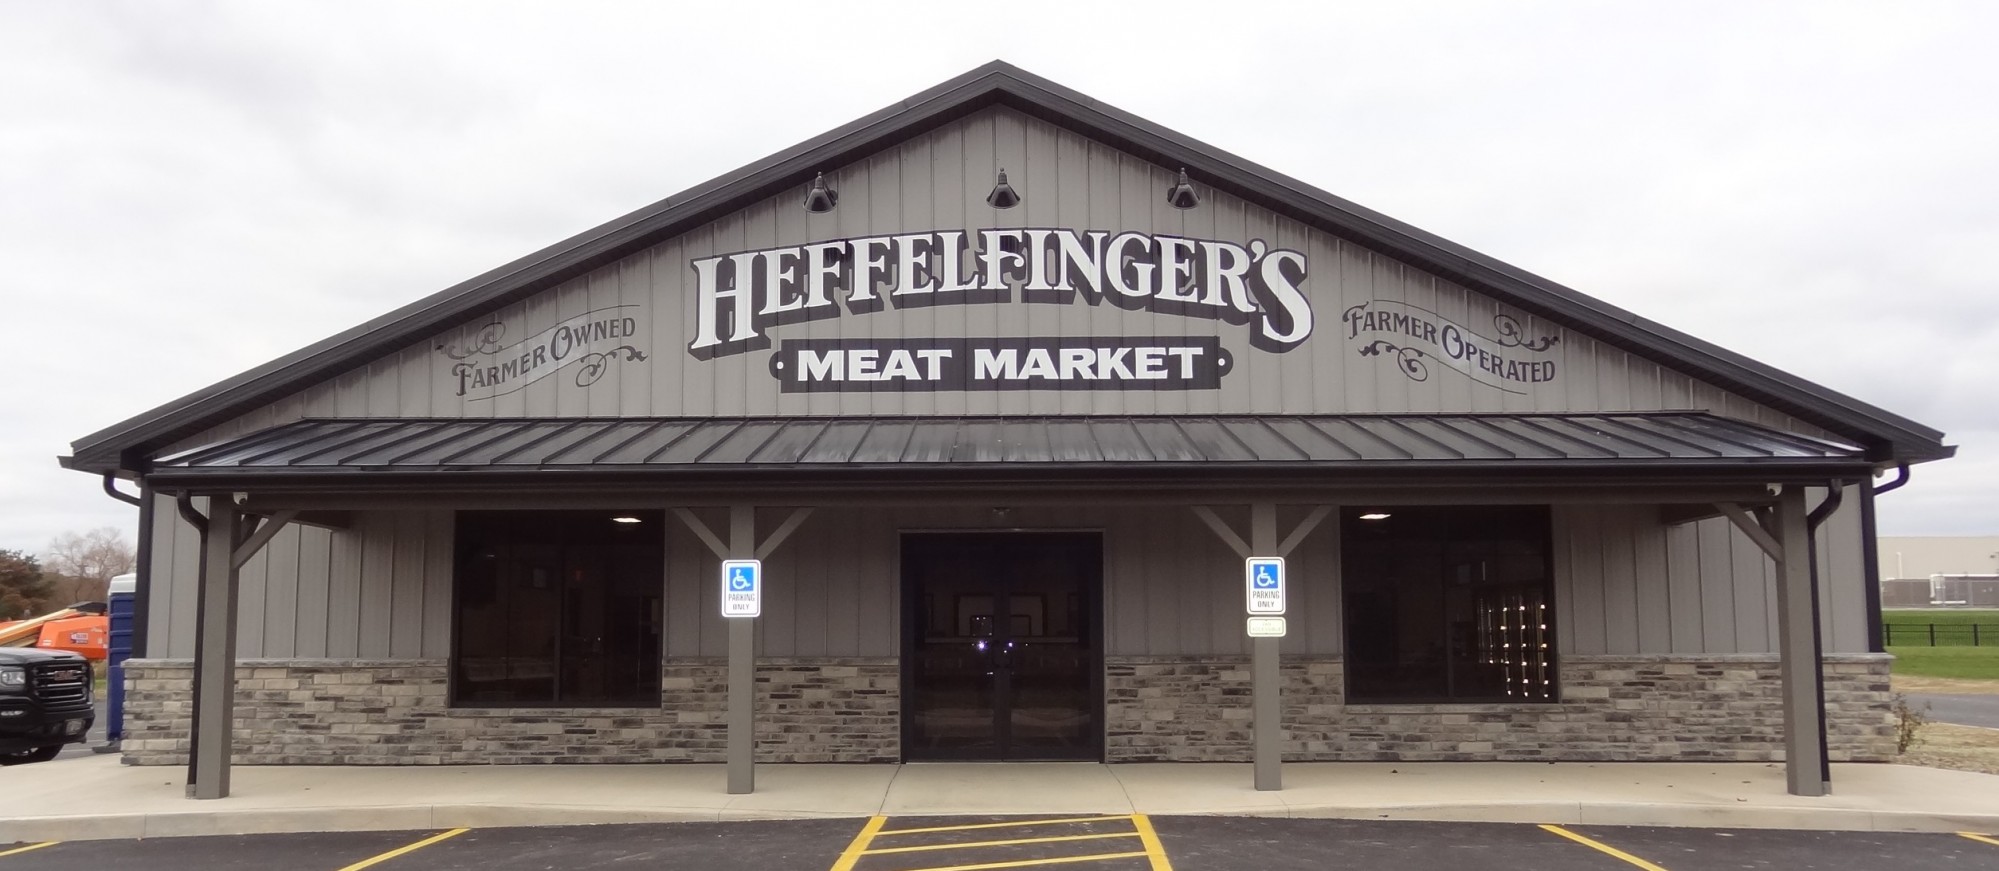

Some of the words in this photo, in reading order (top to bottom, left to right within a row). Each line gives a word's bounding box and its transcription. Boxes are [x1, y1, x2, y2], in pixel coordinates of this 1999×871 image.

[690, 228, 1313, 347] HEFFELFINGER'S
[452, 344, 546, 396] FARMER
[550, 317, 636, 361] OWNED
[797, 349, 953, 382] MEAT
[974, 346, 1204, 381] MARKET
[1342, 301, 1438, 345] FARMER
[1441, 324, 1556, 383] OPERATED
[728, 593, 755, 602] PARKING
[1252, 590, 1280, 599] PARKING
